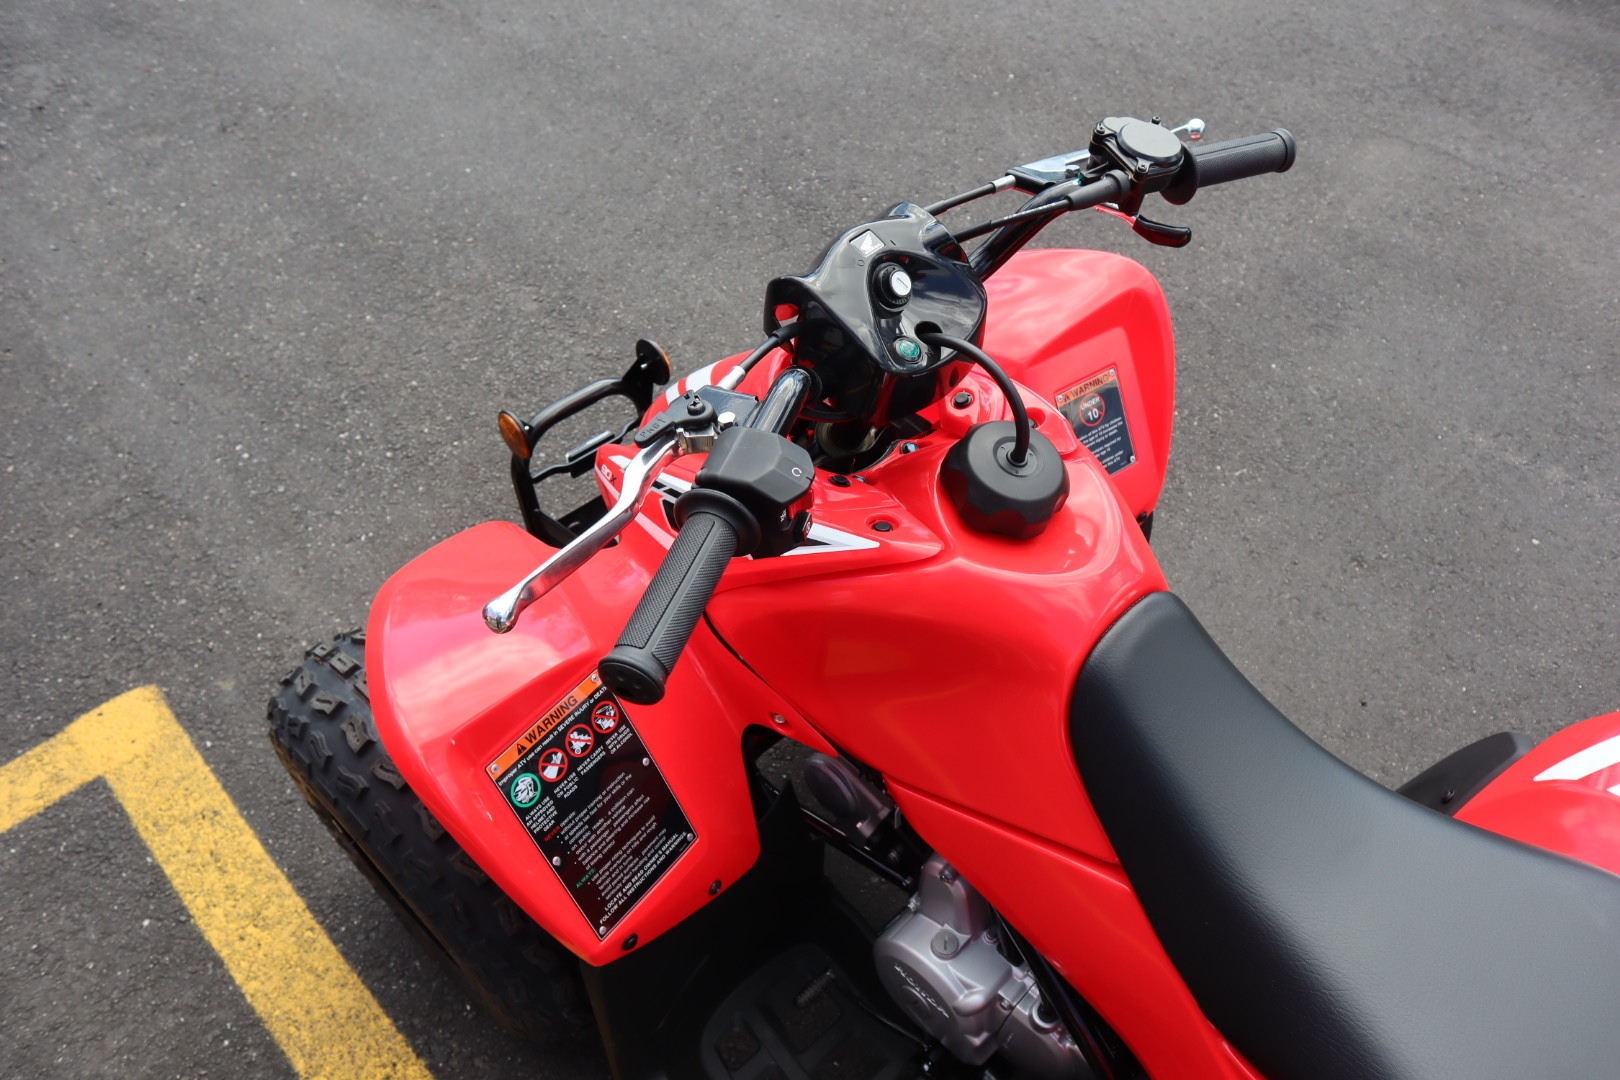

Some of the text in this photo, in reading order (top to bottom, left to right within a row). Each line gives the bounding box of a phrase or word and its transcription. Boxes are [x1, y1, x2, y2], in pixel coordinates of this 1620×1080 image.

[1070, 373, 1109, 398] WARNING
[1080, 395, 1100, 410] UNDER
[1087, 406, 1099, 421] 10
[524, 693, 578, 745] WARNING
[497, 766, 518, 787] Improper
[516, 757, 527, 769] ATV
[525, 751, 535, 761] use
[533, 744, 542, 753] can
[541, 733, 554, 746] result
[556, 714, 575, 732] SEVERE
[573, 700, 590, 717] INJURY
[604, 723, 626, 745] NEVER USE
[607, 727, 630, 750] WITH DRUGS
[609, 731, 633, 754] OR ALCOHOL
[576, 744, 604, 772] NEVER CARRY
[580, 750, 605, 775] PASSENGERS
[553, 771, 576, 794] NEVER USE
[556, 775, 578, 798] ON PUBLIC
[563, 783, 577, 799] ROADS
[524, 795, 550, 821] ALWAYS USE
[525, 799, 554, 827] AN APPROVED
[529, 804, 555, 830] HELMET AND
[533, 809, 558, 834] PROTECTIVE
[542, 819, 555, 832] GEAR
[543, 824, 560, 842] NEVER
[604, 832, 678, 911] LOCATE AND READ OWNER'S MANUAL
[599, 902, 619, 924] FOLLOW
[617, 893, 627, 905] ALL
[625, 862, 657, 896] INSTRUCTIONS
[655, 853, 666, 865] AND
